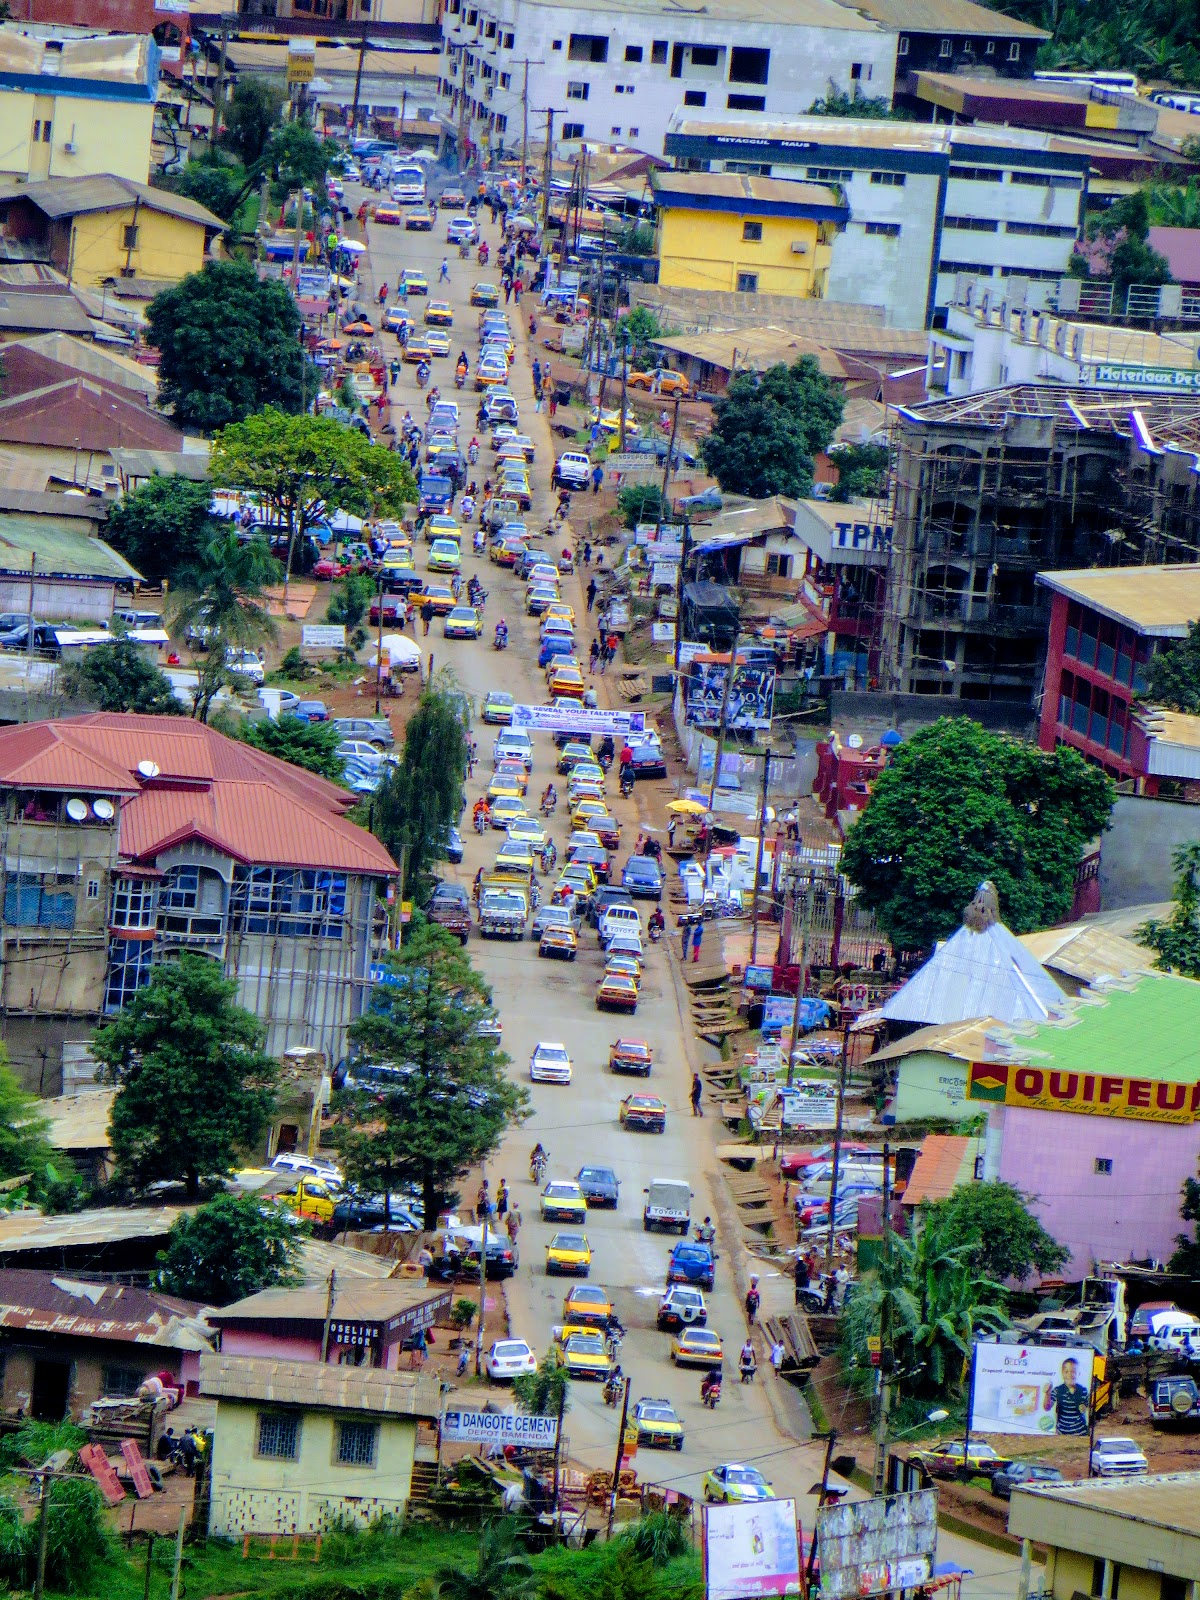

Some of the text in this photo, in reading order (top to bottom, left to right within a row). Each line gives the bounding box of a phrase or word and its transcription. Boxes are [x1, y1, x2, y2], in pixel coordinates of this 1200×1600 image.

[781, 140, 810, 148] HAUS
[835, 522, 894, 551] TPM
[533, 706, 620, 717] REVEAL YOUR TALENT
[610, 926, 635, 934] TOYOTA
[1027, 1095, 1055, 1107] The
[1059, 1099, 1097, 1114] King
[1103, 1105, 1120, 1117] of
[1122, 1106, 1192, 1124] Building
[653, 1208, 683, 1216] TOYOTA
[336, 1334, 370, 1347] DECOR
[463, 1413, 558, 1434] DANGOTE CEMENT
[467, 1428, 499, 1437] DEPOT
[501, 1430, 549, 1440] BAMENDA
